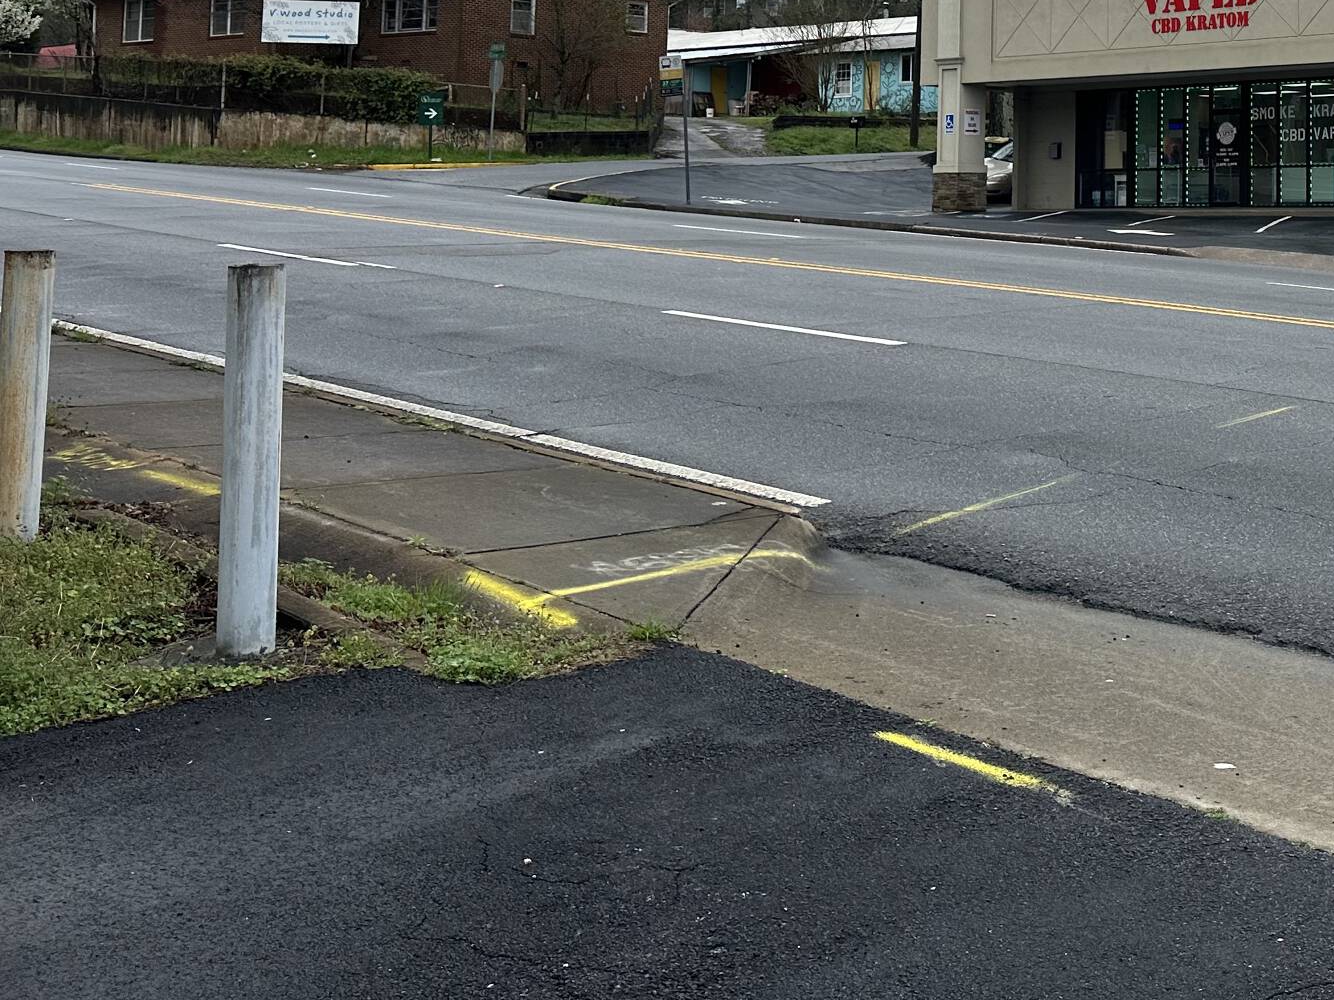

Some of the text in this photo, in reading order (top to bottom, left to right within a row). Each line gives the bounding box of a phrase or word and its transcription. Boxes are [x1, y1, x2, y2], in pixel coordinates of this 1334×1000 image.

[1151, 11, 1249, 34] CBD KRATOM
[1282, 128, 1306, 142] CBD
